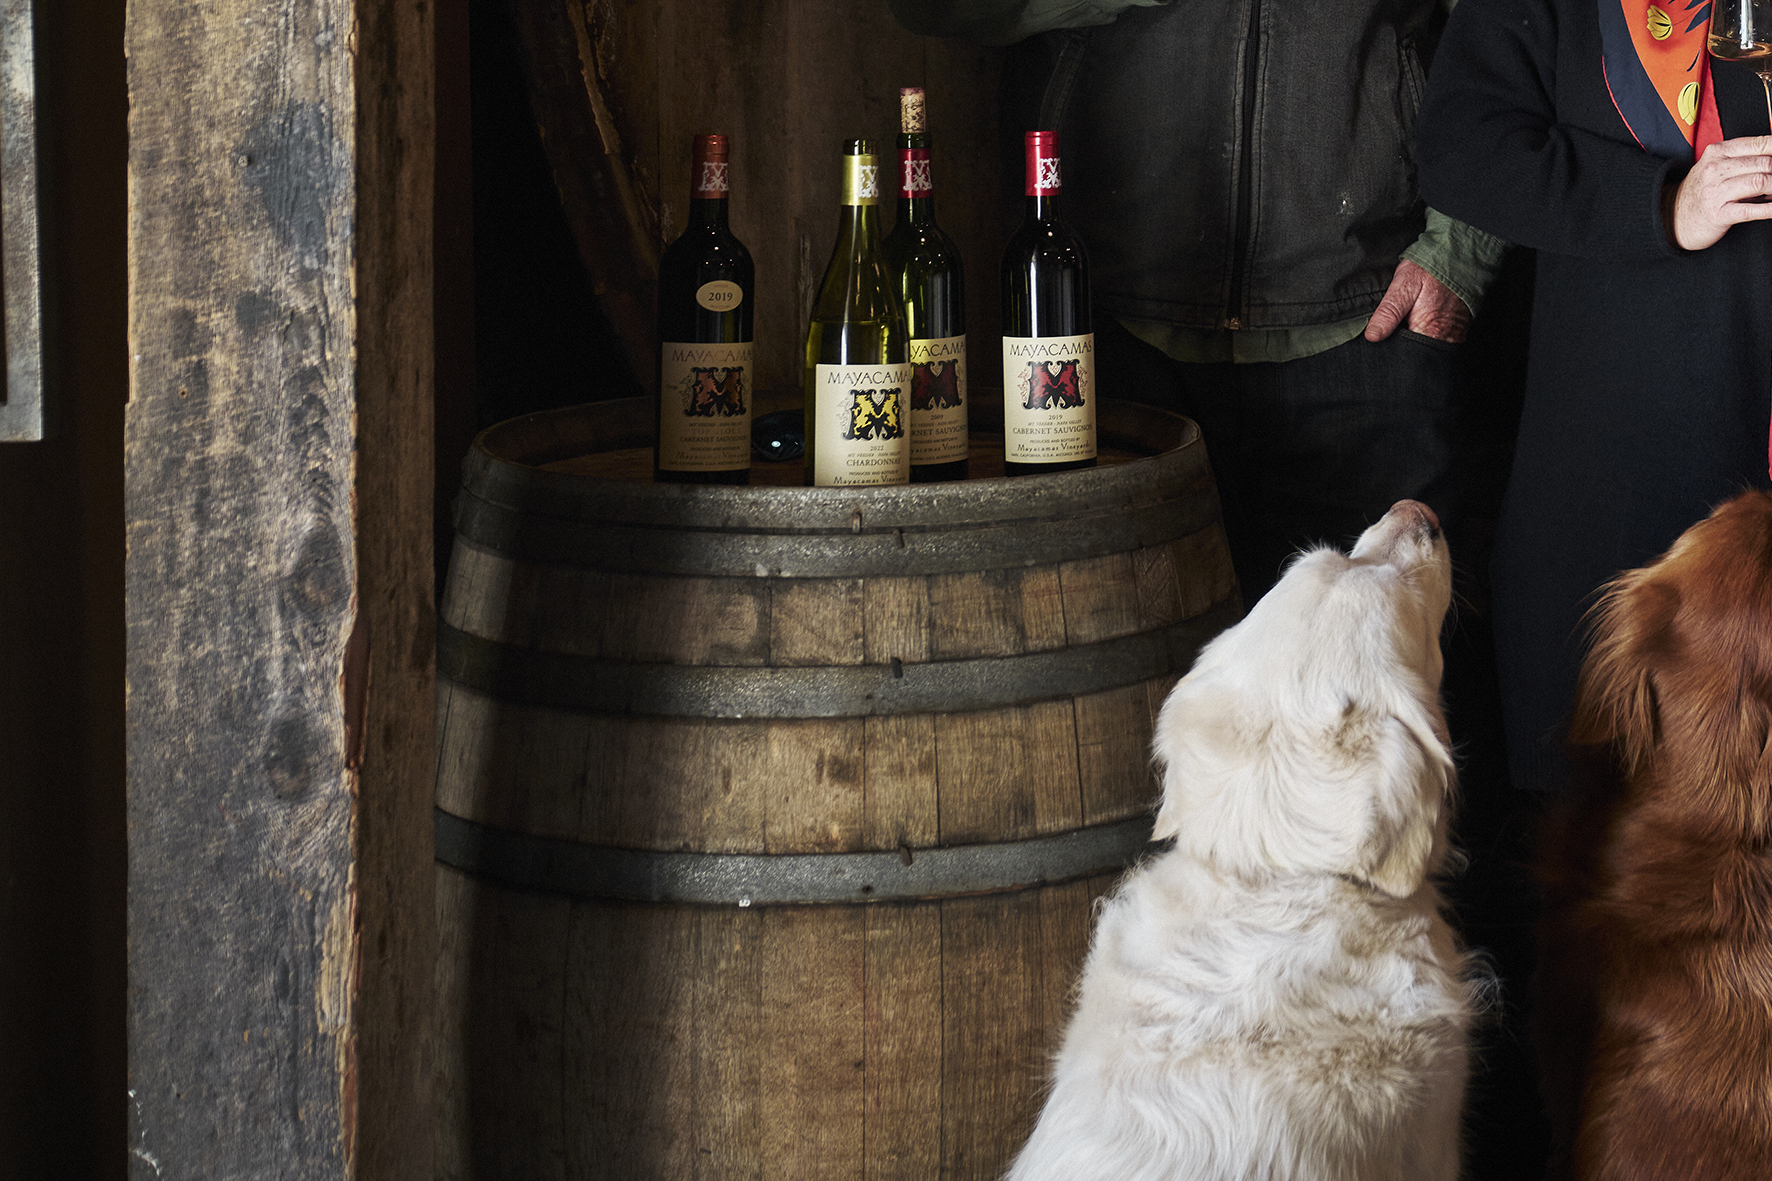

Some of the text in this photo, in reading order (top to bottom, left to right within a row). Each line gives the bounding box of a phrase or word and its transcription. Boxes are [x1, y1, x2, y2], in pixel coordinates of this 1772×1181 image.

[708, 291, 733, 302] 2019
[1009, 340, 1093, 358] MAYACAMAS
[1012, 426, 1051, 435] CABERNET
